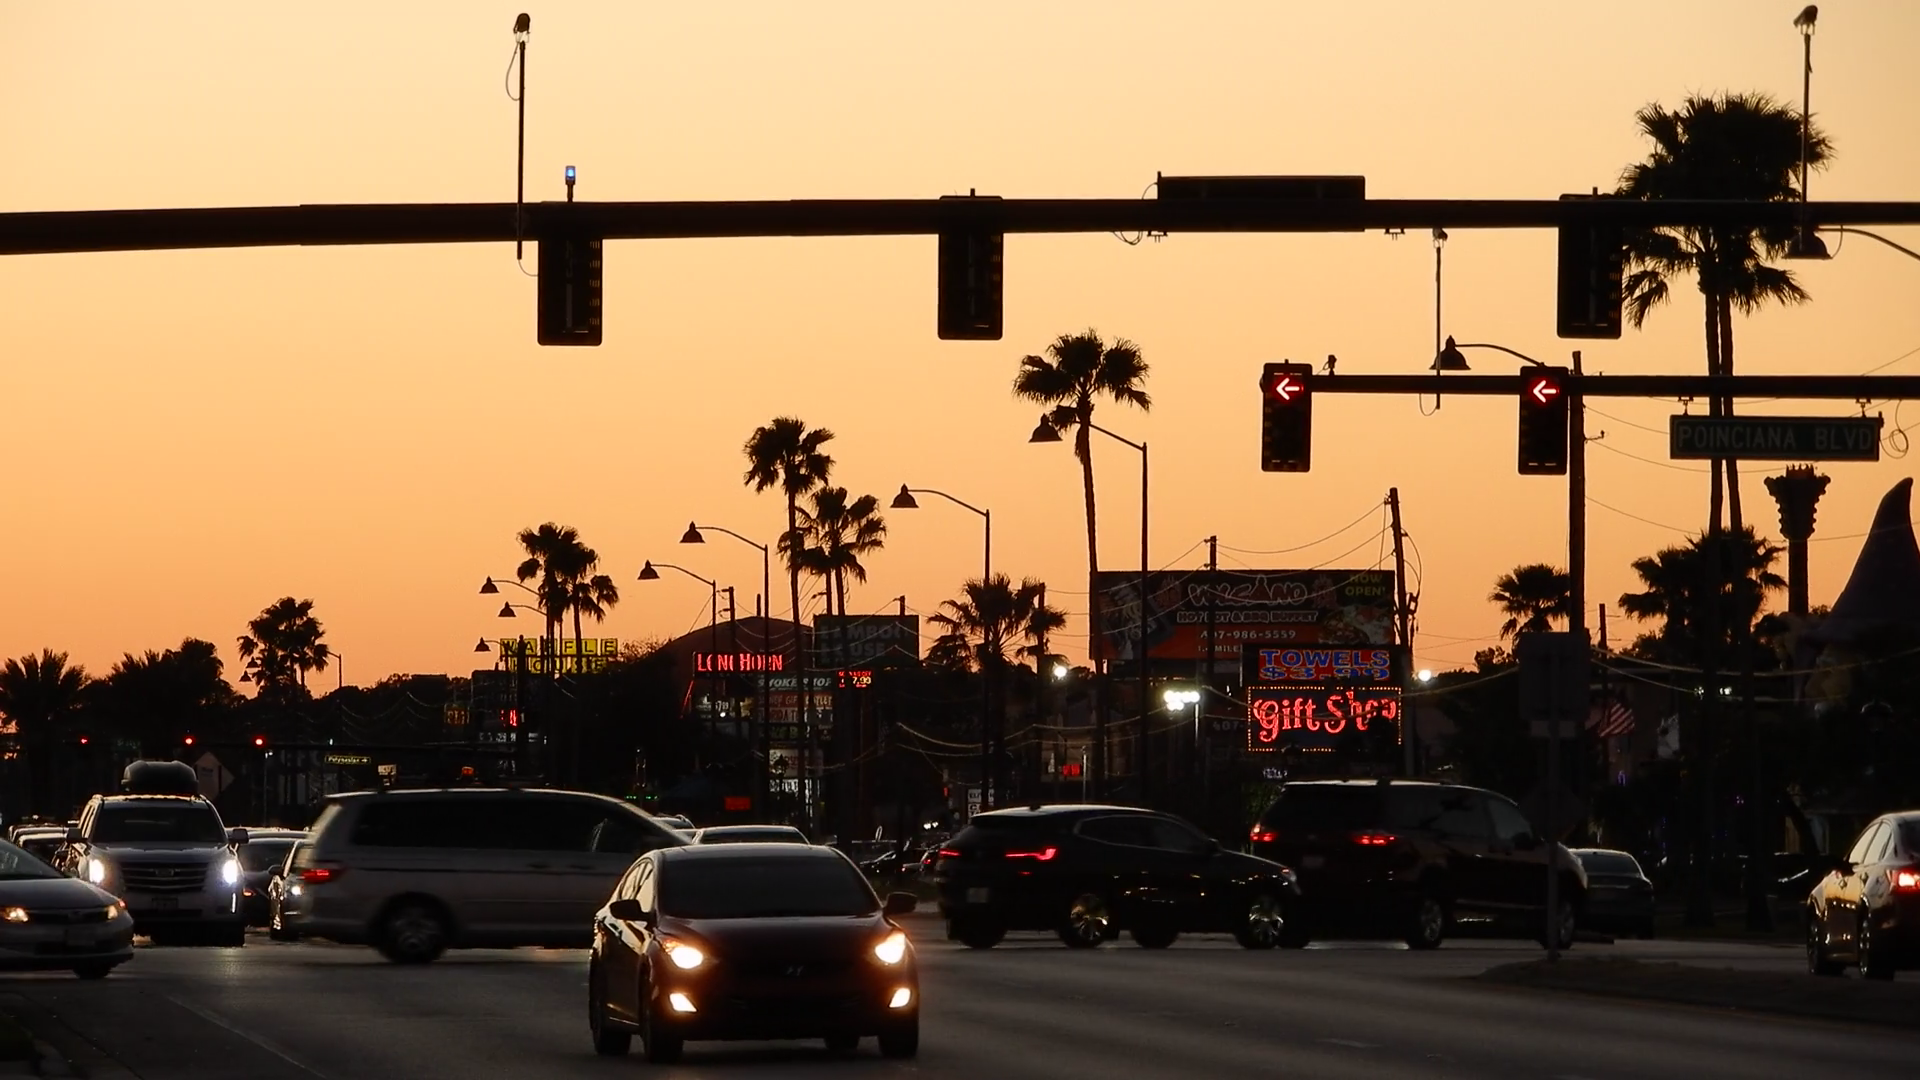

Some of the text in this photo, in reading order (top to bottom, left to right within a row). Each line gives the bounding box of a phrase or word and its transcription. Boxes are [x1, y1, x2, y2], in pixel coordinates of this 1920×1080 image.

[1678, 425, 1872, 450] POINCIANA BLVD
[1188, 575, 1308, 607] VLCANO
[1200, 630, 1297, 640] 47-986-5559
[1259, 649, 1390, 668] TOWELS
[757, 678, 798, 687] SOKE
[1259, 667, 1390, 681] $3.99
[1252, 697, 1321, 743] Gift
